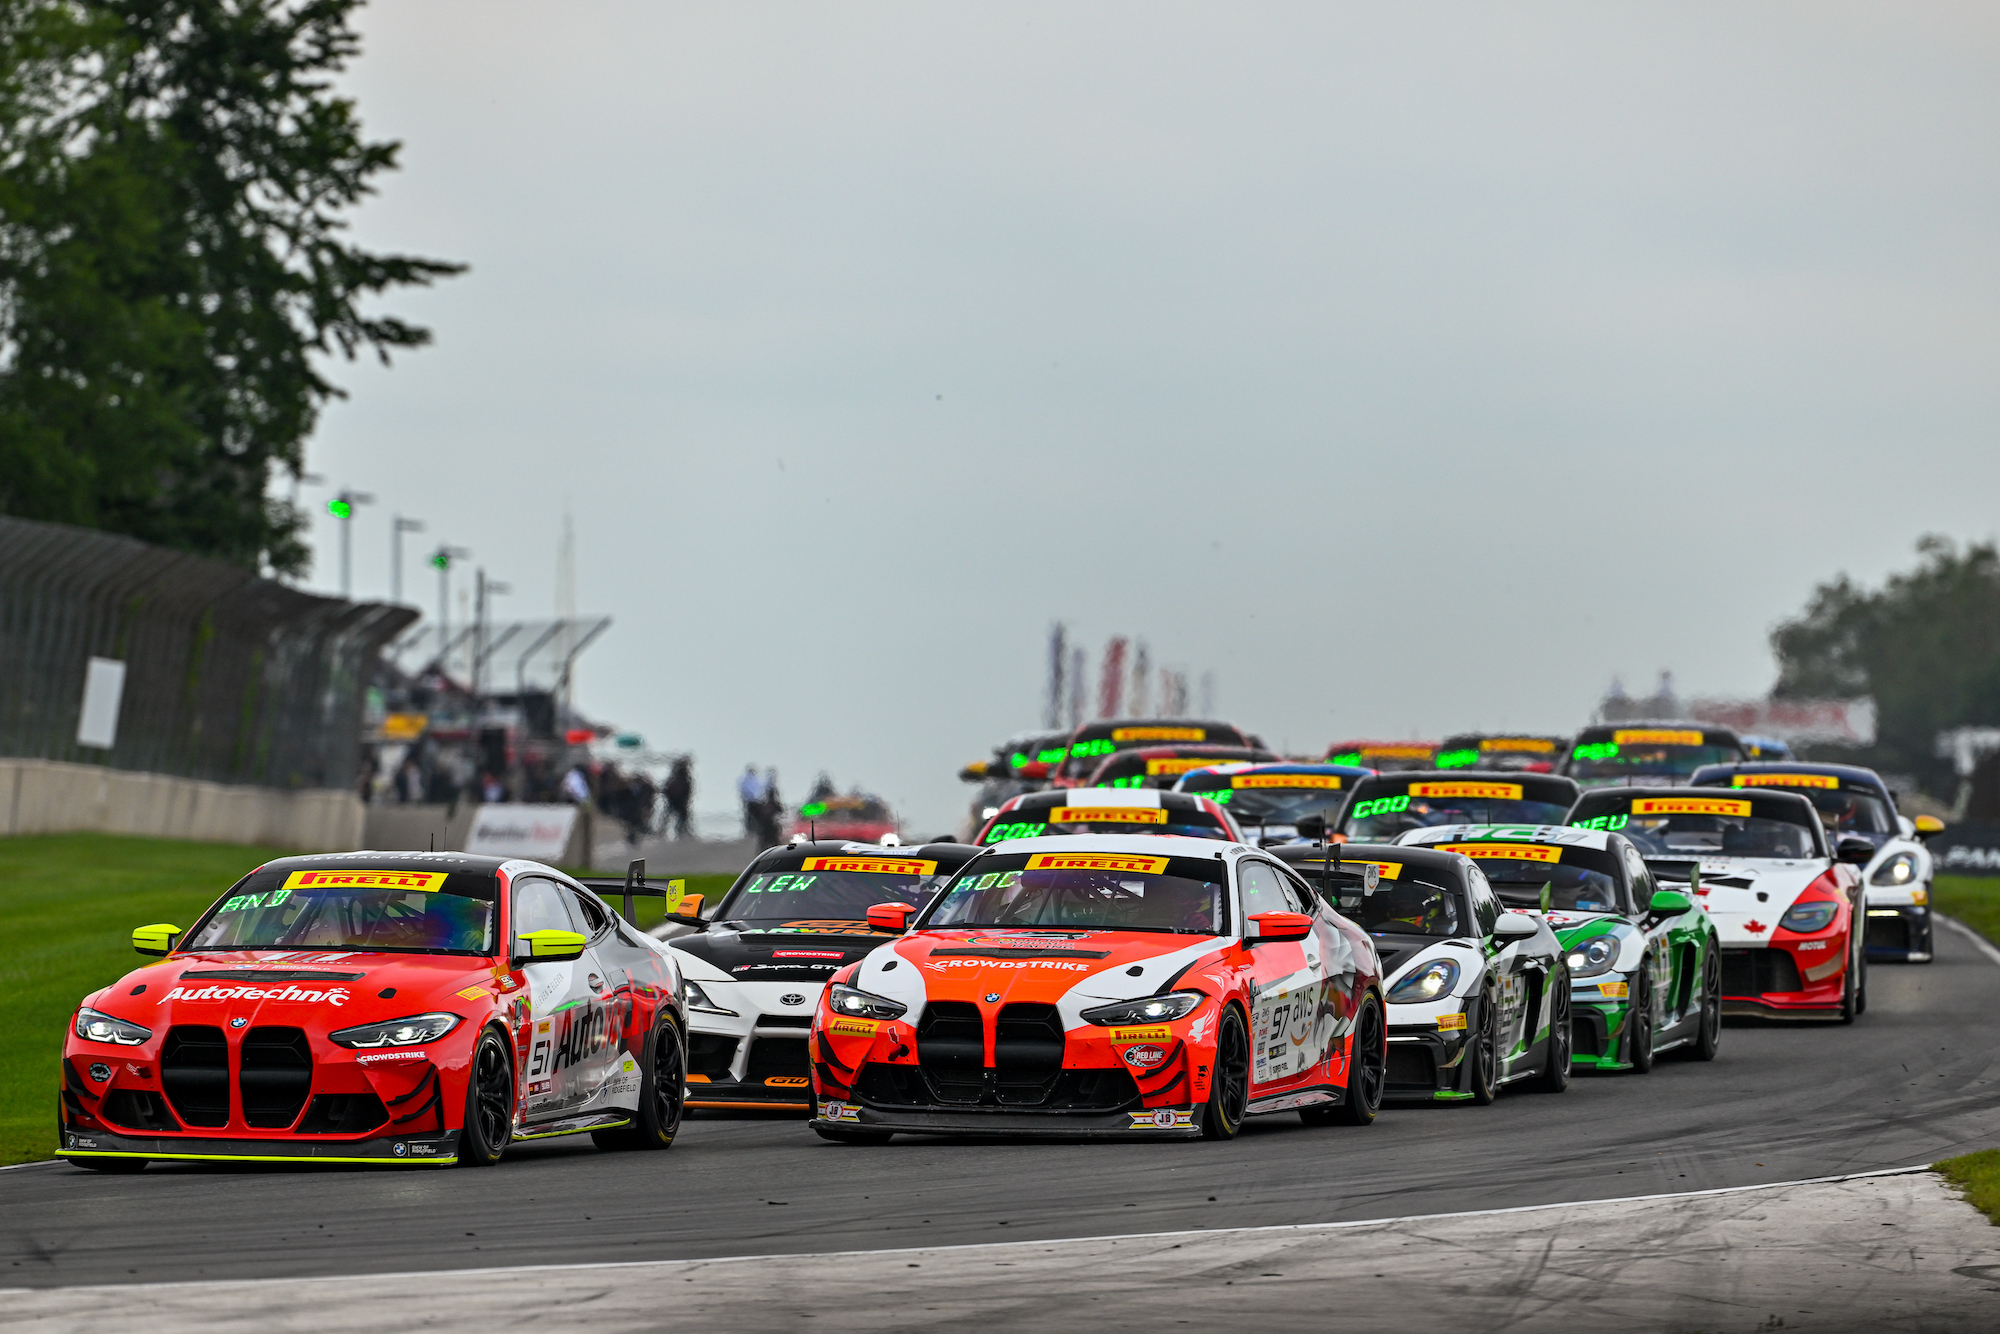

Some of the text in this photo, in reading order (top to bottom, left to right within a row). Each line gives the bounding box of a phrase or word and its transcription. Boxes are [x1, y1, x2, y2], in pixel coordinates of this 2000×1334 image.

[1745, 777, 1828, 788] PIRELLI
[1421, 786, 1511, 796] PIRELLI
[1644, 802, 1741, 813] PIRELLI
[1062, 810, 1157, 822] PIRELLI
[389, 855, 467, 863] PROJECT
[1039, 856, 1156, 871] PIRELLI
[814, 858, 925, 875] PIRELLI
[299, 871, 432, 887] PIRELLI
[748, 875, 817, 893] LEW
[1798, 940, 1826, 951] MOTUL
[934, 960, 1090, 971] CROWDSTRIKE
[157, 985, 349, 1006] AutoTechnic
[1293, 987, 1314, 1023] aws
[833, 1020, 874, 1034] PIRELLI
[1270, 1004, 1291, 1041] 97
[1438, 1015, 1465, 1029] PIRELLI
[1115, 1029, 1166, 1040] PIRELLI
[360, 1051, 426, 1062] CROWDSTRIKE
[531, 1040, 551, 1076] 51
[1150, 1051, 1163, 1059] LINE
